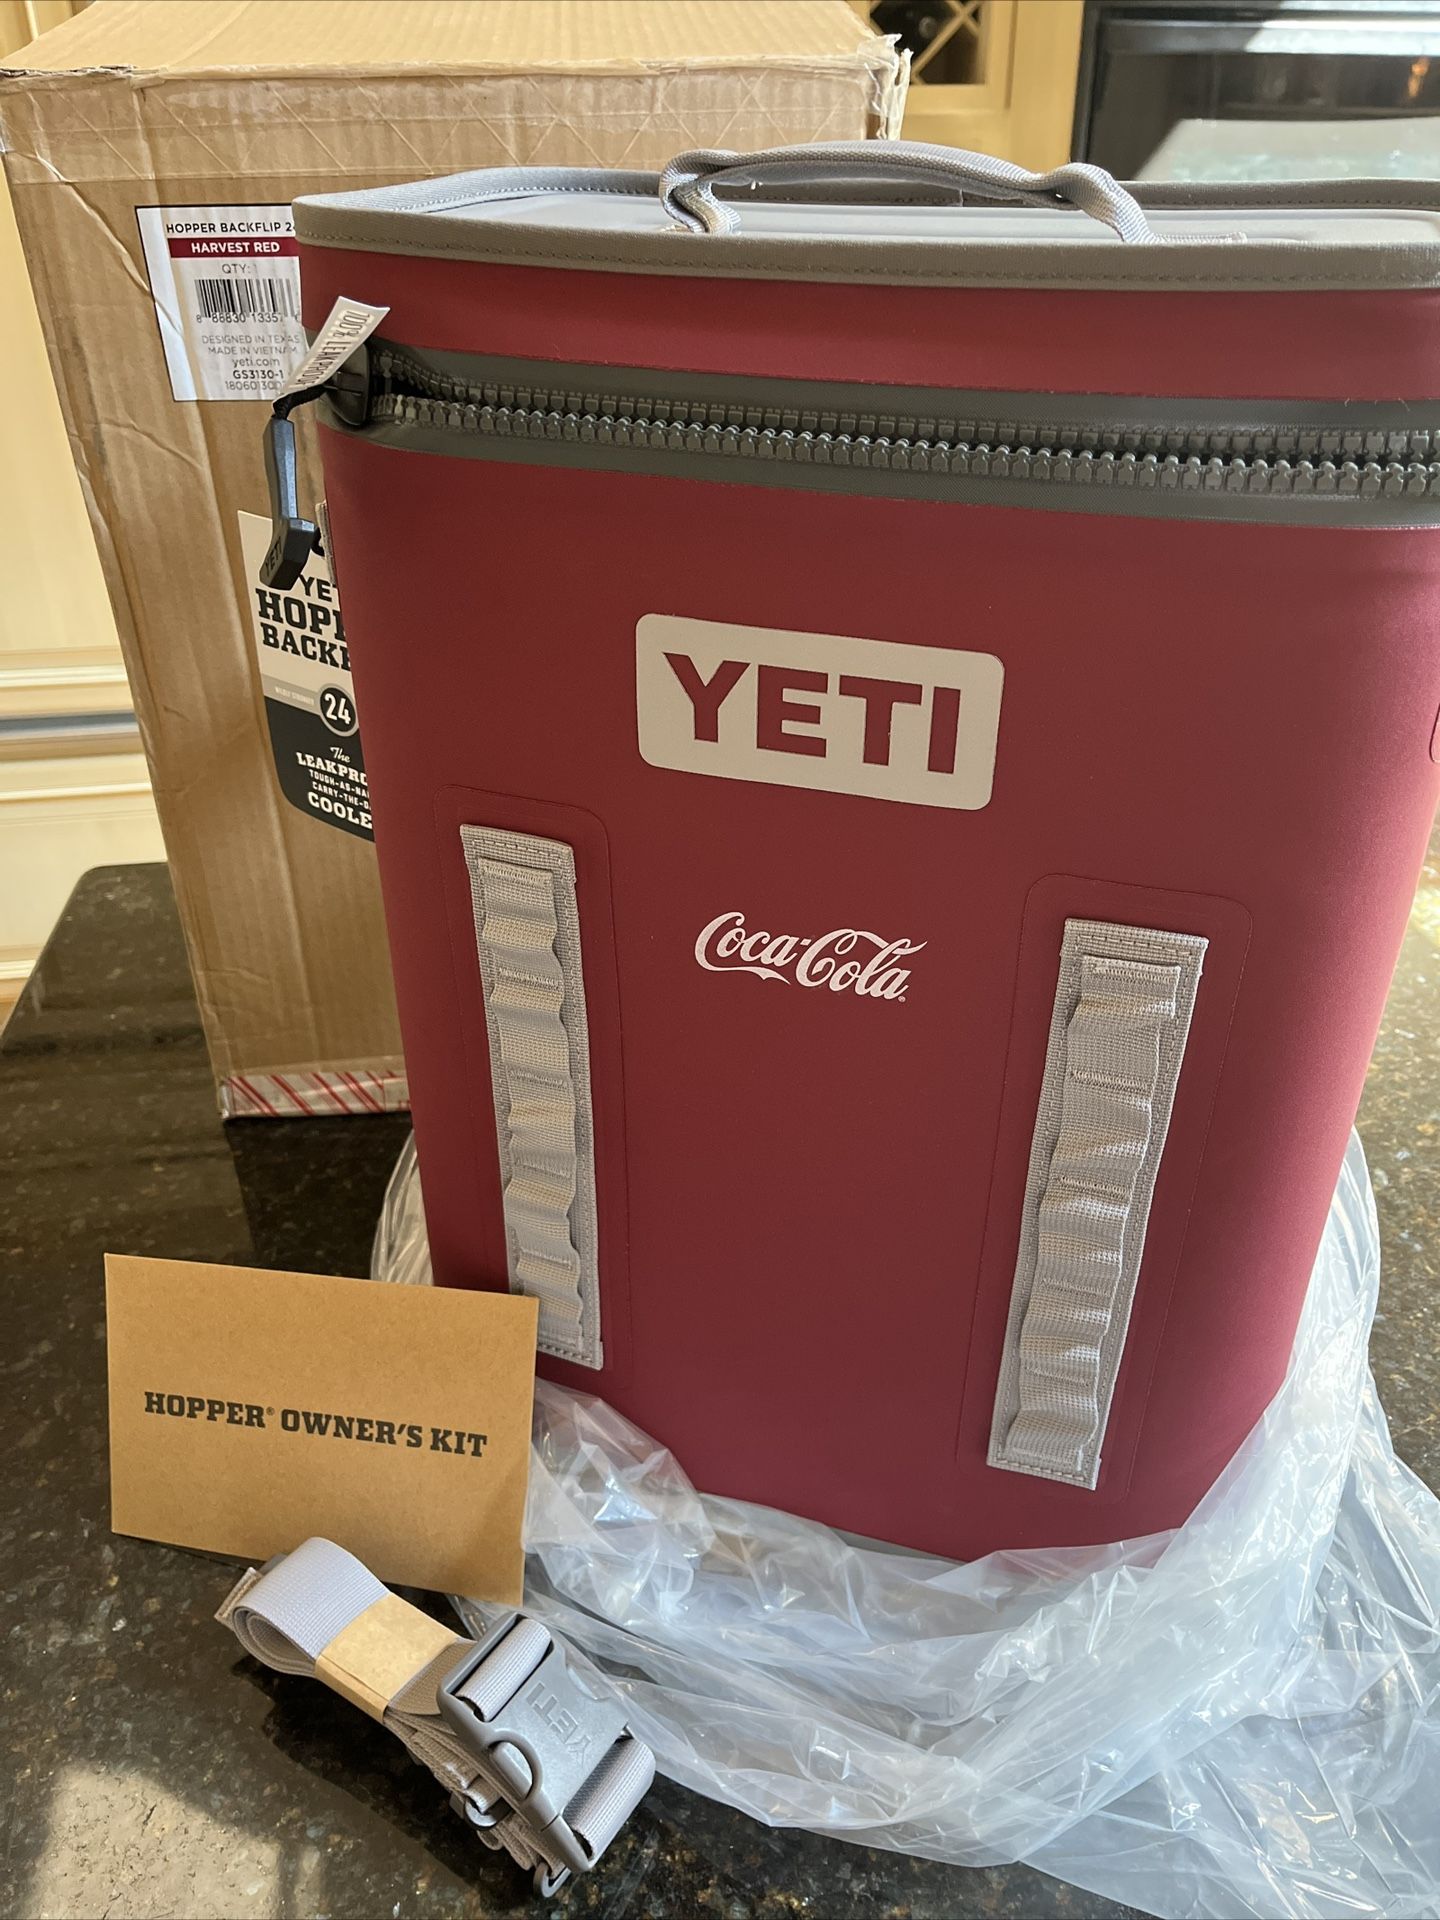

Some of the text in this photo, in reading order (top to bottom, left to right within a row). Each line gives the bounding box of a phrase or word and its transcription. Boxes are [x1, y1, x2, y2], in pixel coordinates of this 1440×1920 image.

[166, 221, 294, 234] HOPPER BACKFLIP 2
[191, 241, 280, 253] HARVEST RED
[222, 264, 251, 274] QTY:
[333, 310, 370, 338] 100%
[202, 335, 300, 344] DESIGNED IN TEXAS
[208, 347, 238, 355] MADE
[252, 346, 297, 354] VIETNAM
[232, 358, 280, 368] yeti.com
[233, 370, 284, 379] GS3130-1
[265, 535, 282, 577] YETI
[324, 693, 351, 725] 24
[662, 651, 961, 774] YETI
[330, 746, 351, 763] The
[312, 781, 371, 810] CARRY-THE-D
[307, 791, 373, 830] COOLE
[280, 1408, 423, 1448] OWNER'S
[430, 1427, 488, 1458] KIT
[526, 1681, 592, 1767] YETI
